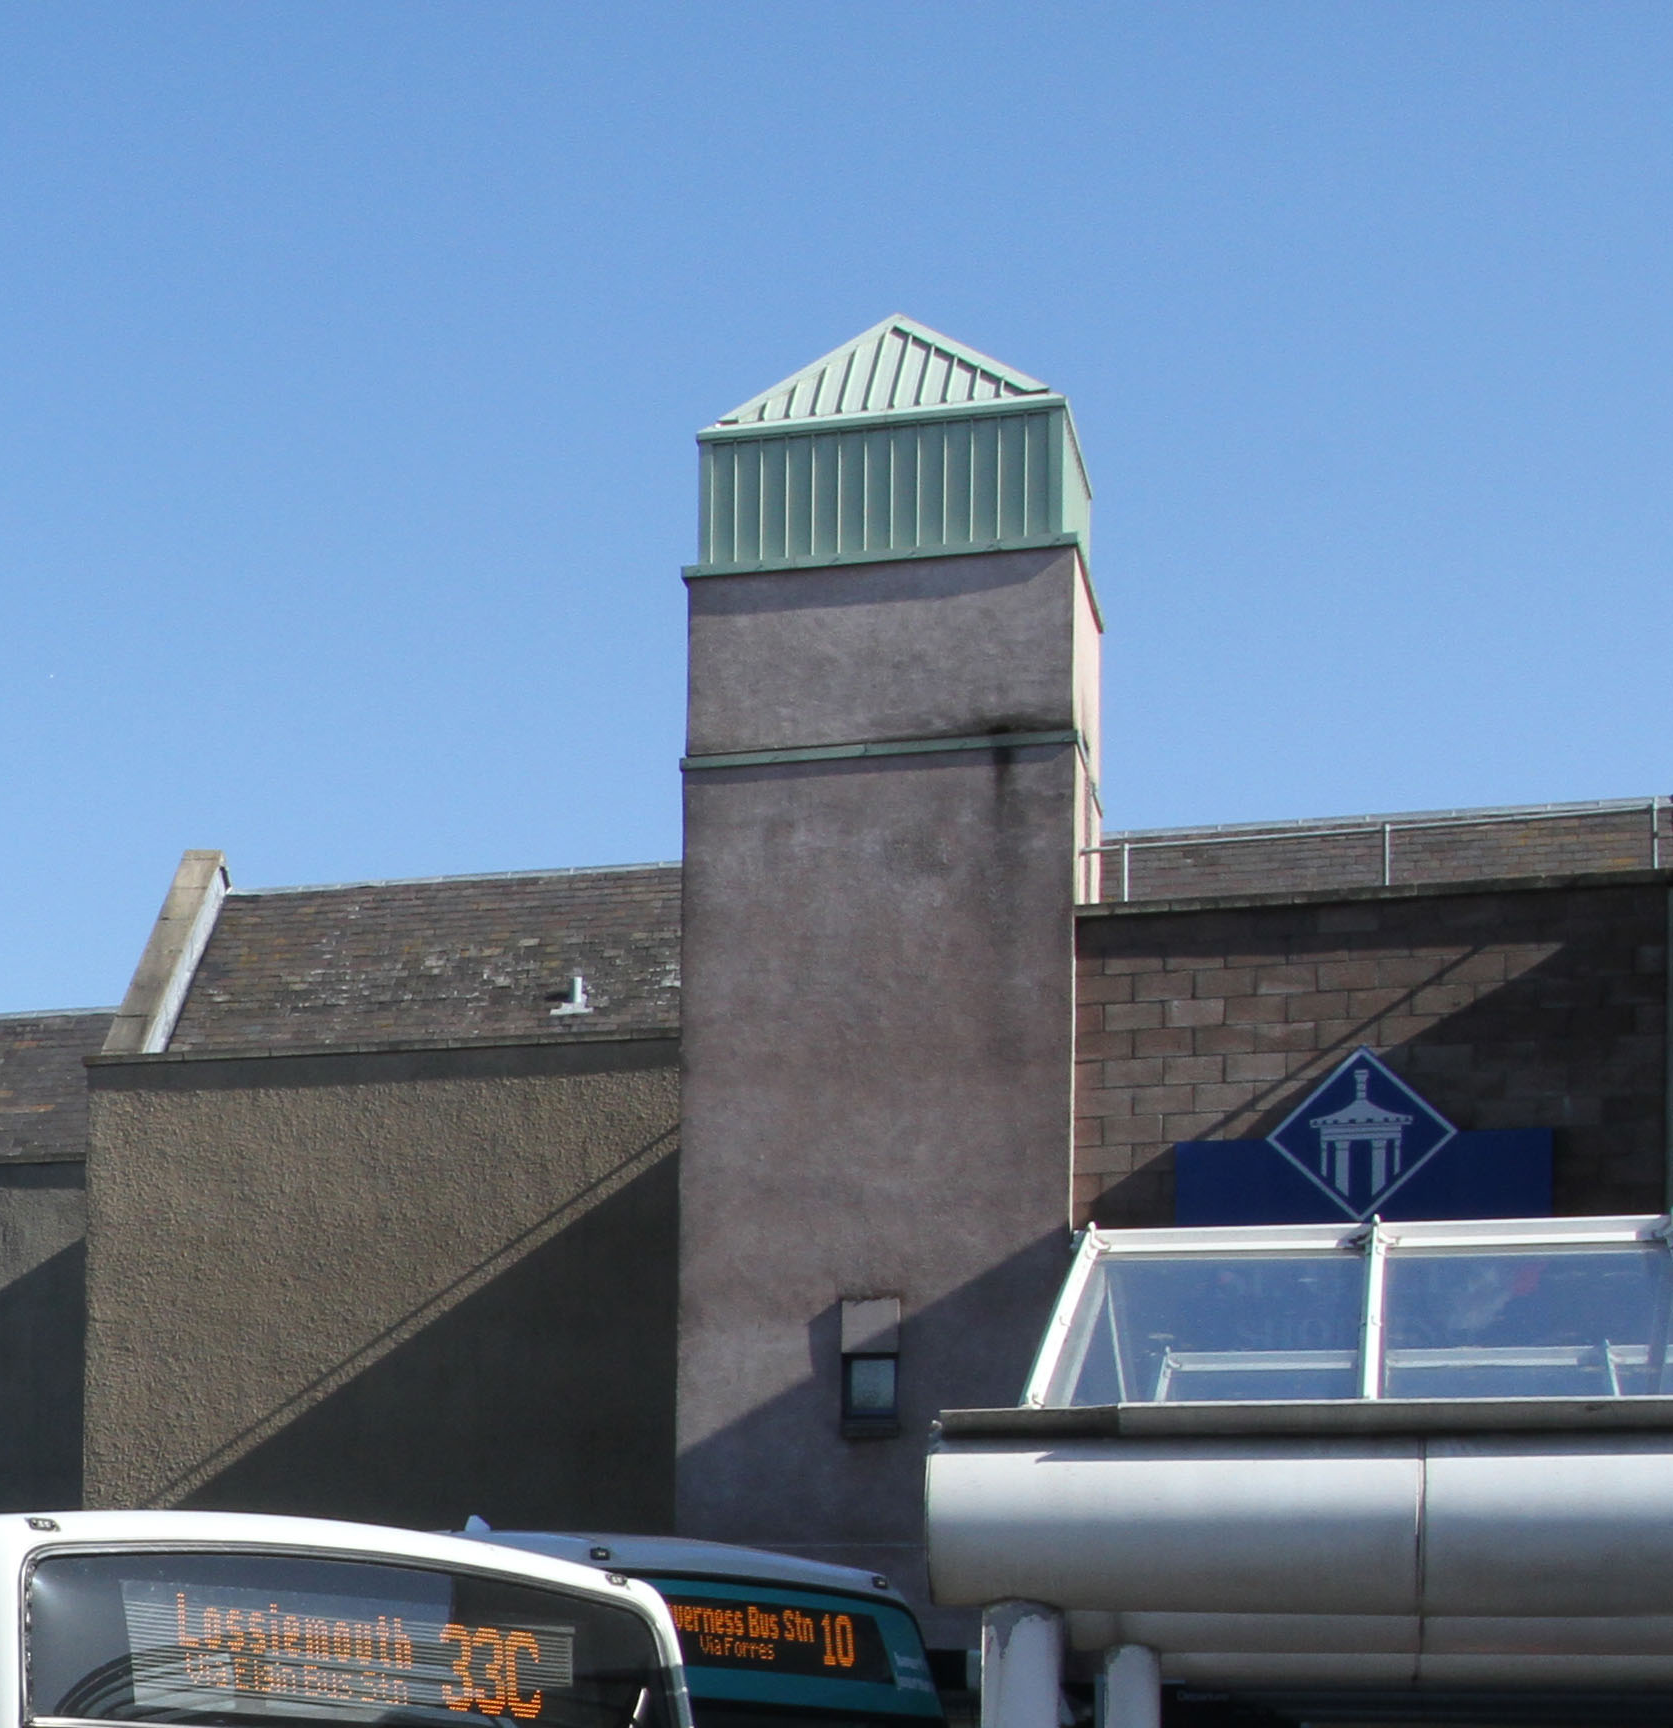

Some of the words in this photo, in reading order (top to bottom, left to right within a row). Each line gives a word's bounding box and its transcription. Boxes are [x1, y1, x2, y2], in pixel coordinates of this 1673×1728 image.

[176, 1592, 413, 1670] Lossiemouth
[439, 1623, 542, 1718] 33C
[699, 1635, 722, 1656] Via
[724, 1637, 776, 1661] Forres
[747, 1605, 779, 1640] Bus
[782, 1610, 815, 1643] Stn
[820, 1614, 855, 1668] 10
